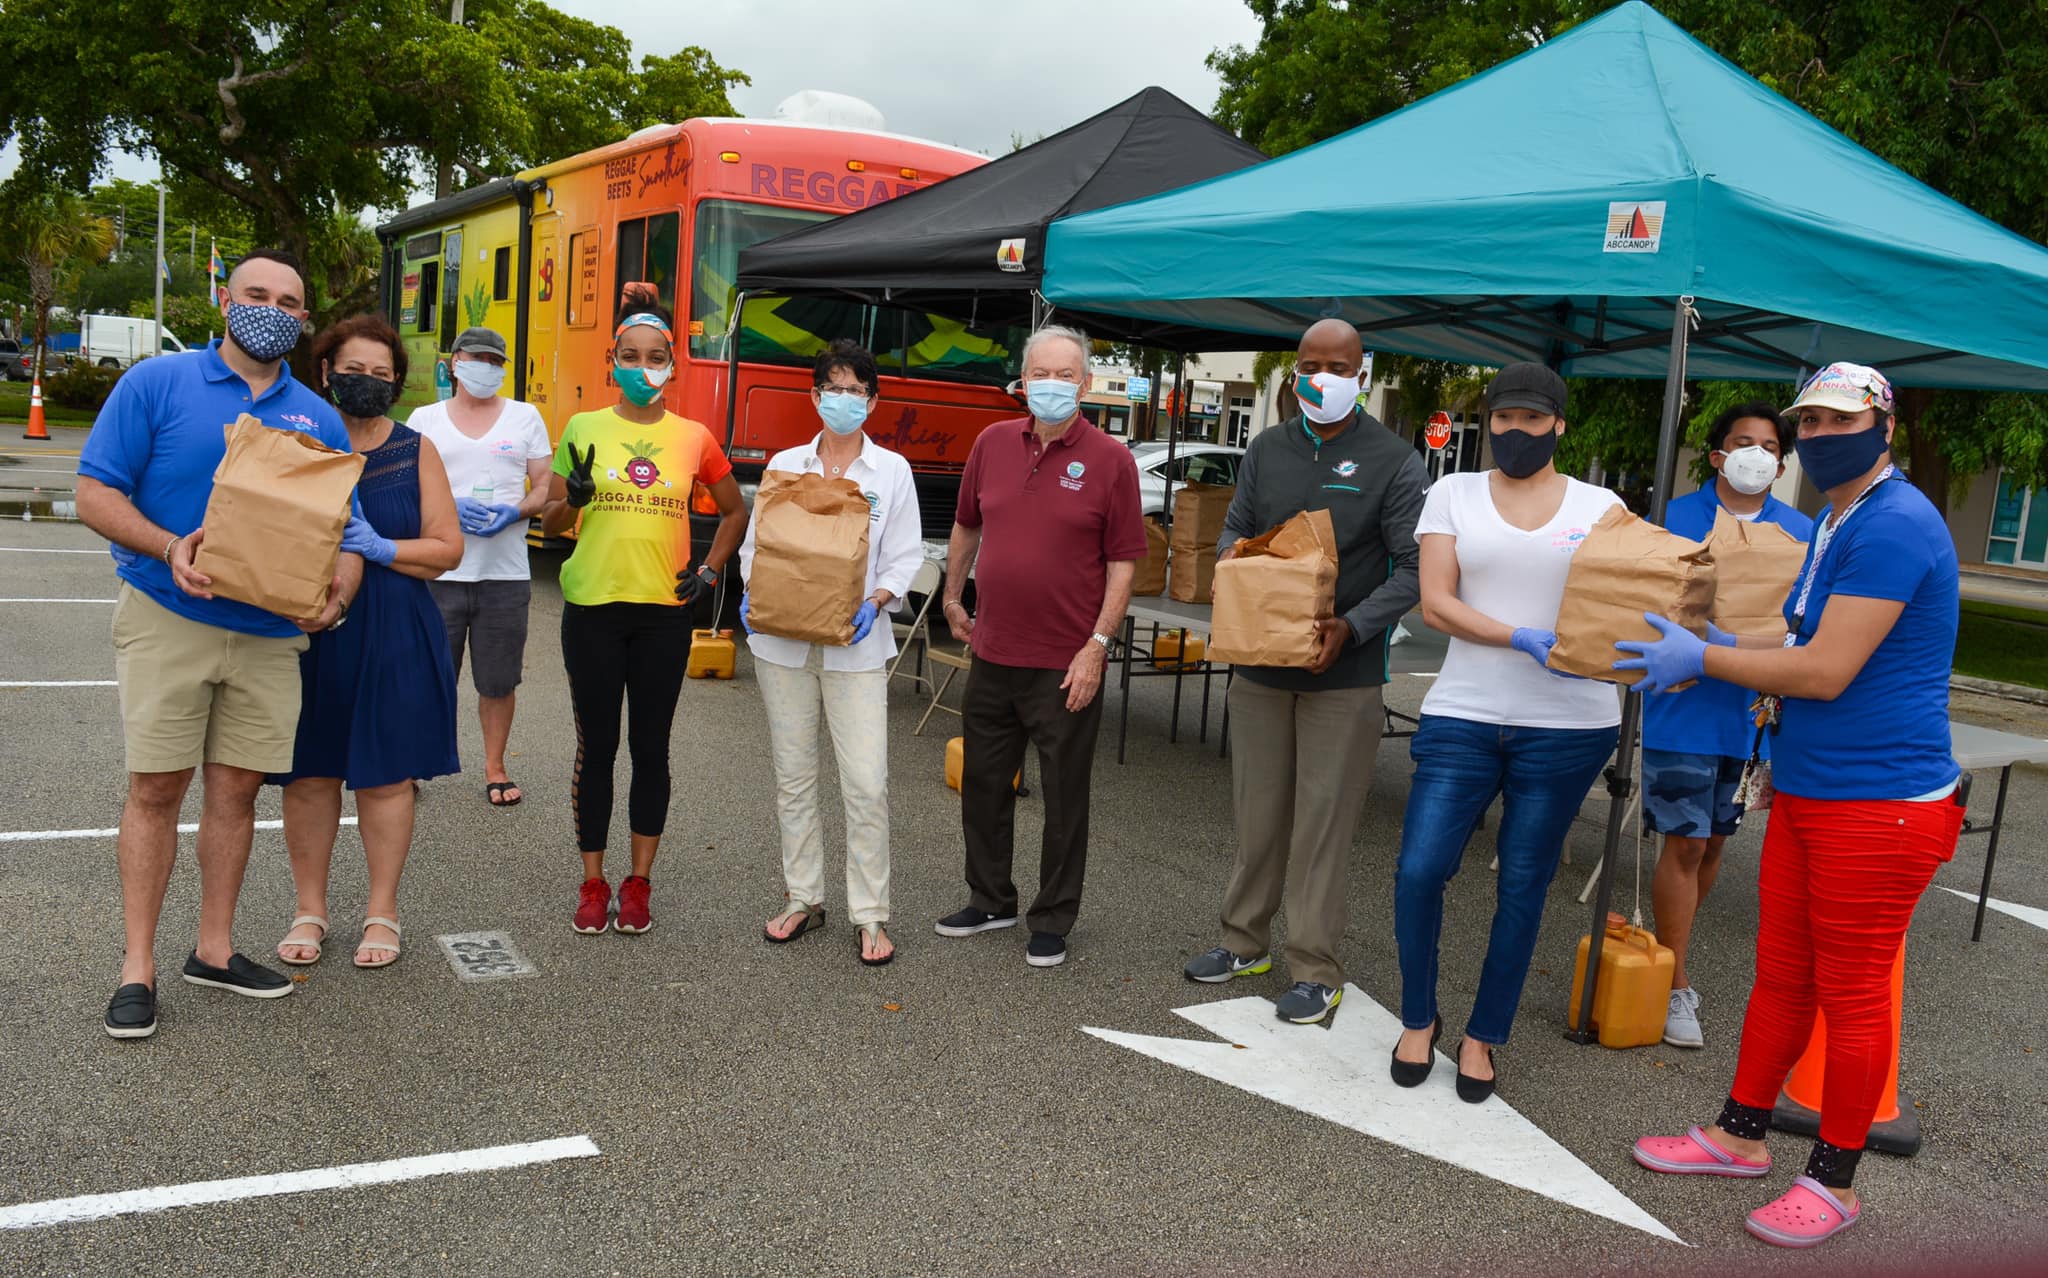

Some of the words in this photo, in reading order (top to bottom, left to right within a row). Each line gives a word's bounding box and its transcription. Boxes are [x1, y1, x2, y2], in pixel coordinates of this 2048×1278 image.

[605, 157, 637, 180] REGGAE
[607, 180, 632, 200] BEETS
[1606, 240, 1656, 249] ABCCANOPY
[1426, 422, 1449, 438] STOP
[652, 496, 686, 511] BEETS
[592, 504, 631, 513] GOURMET
[634, 506, 659, 515] FOOD
[662, 509, 684, 520] TRUCK
